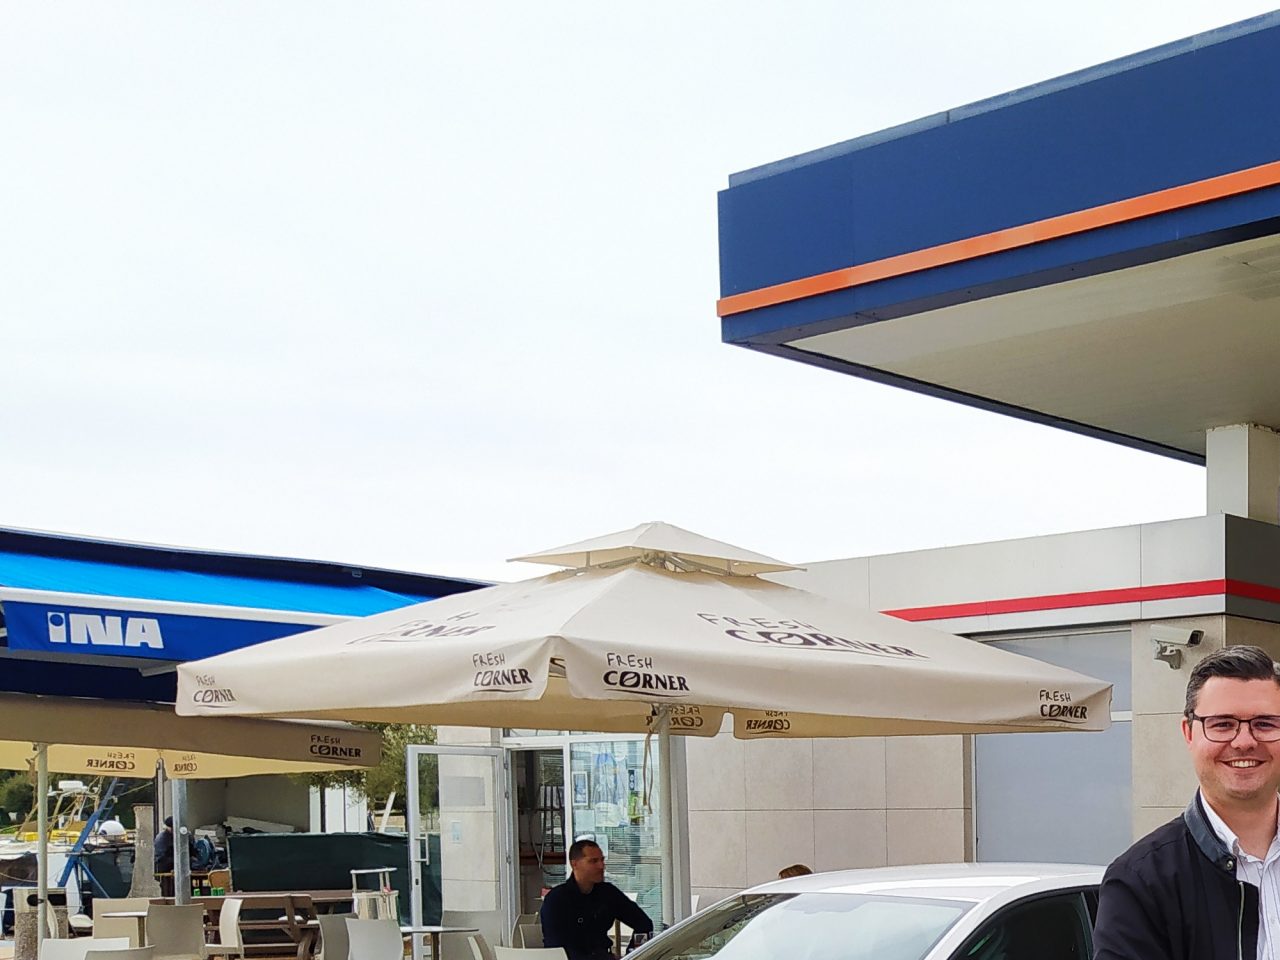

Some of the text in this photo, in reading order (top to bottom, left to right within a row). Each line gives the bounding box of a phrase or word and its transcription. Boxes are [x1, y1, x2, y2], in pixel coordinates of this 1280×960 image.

[472, 653, 505, 668] FRESH
[606, 652, 653, 669] FRESH
[1039, 689, 1072, 702] FRESH
